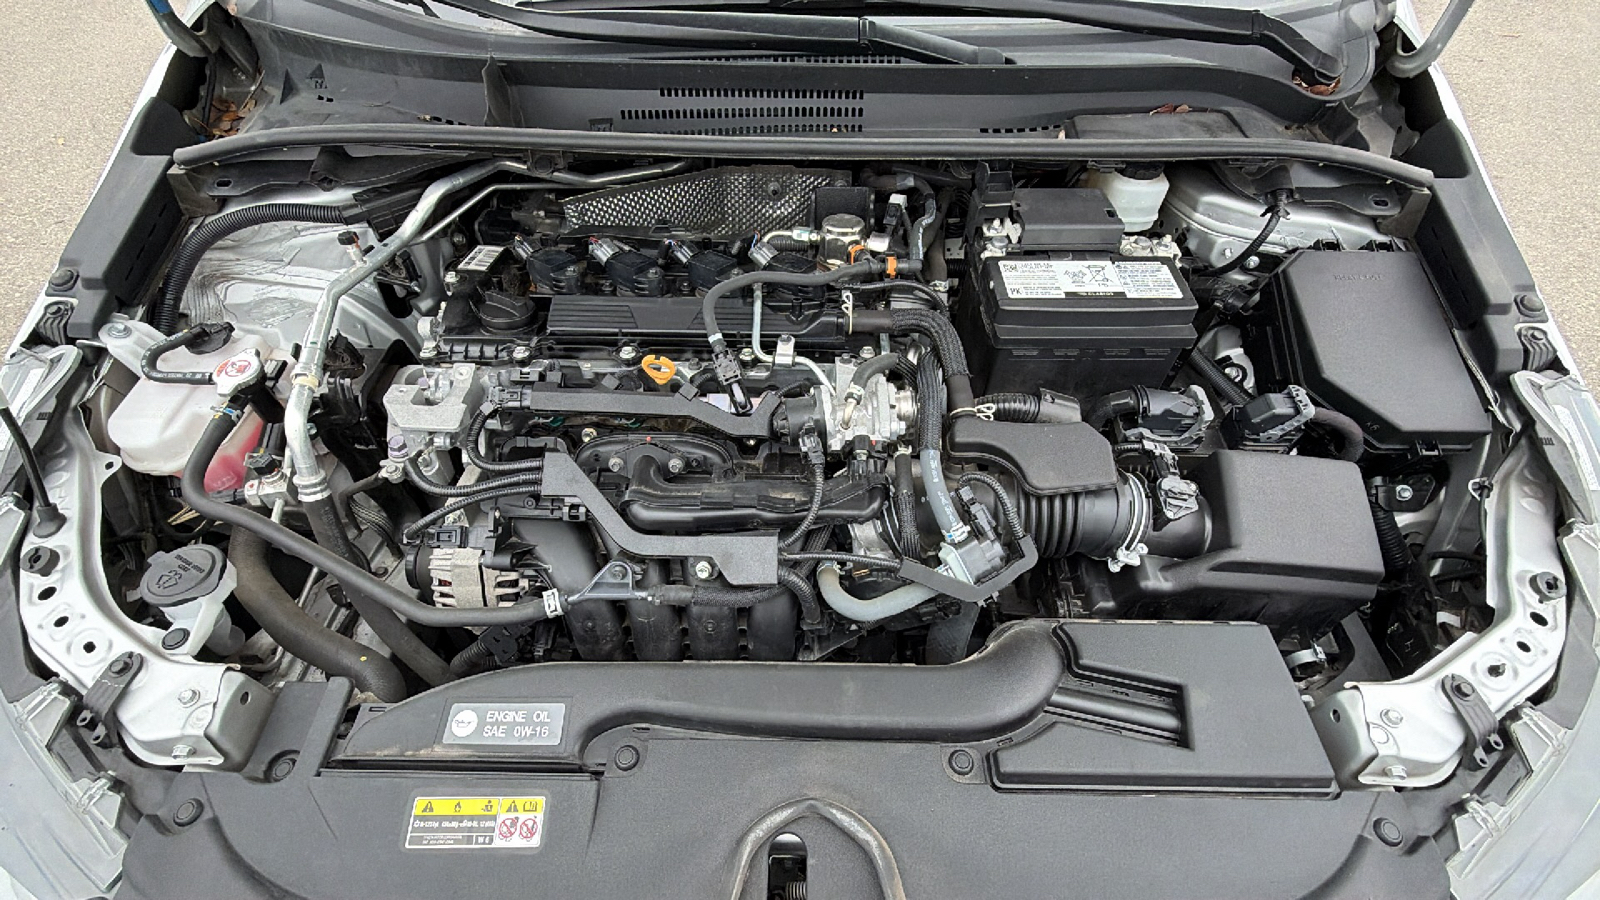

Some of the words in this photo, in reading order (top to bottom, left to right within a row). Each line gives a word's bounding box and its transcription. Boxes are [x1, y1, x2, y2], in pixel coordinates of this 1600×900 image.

[486, 710, 527, 723] ENGINE
[533, 710, 551, 723] OIL
[482, 725, 507, 737] SAE
[513, 726, 549, 737] 0W-16
